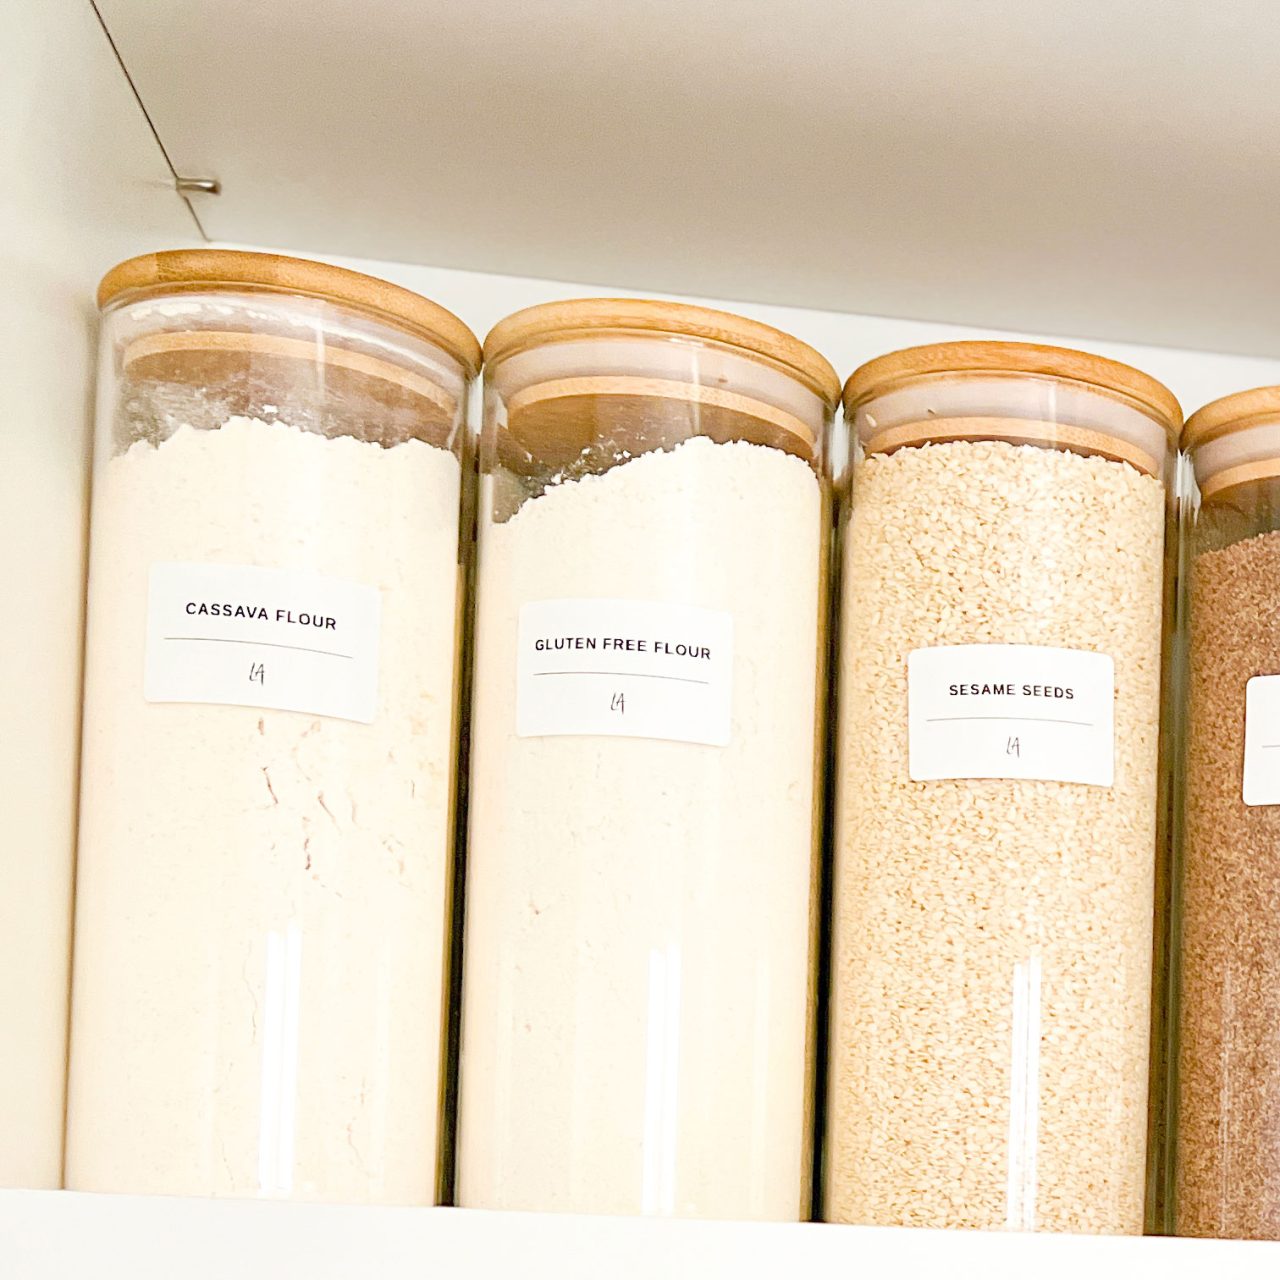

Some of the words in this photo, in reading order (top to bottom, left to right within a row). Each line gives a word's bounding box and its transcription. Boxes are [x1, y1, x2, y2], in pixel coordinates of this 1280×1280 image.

[184, 601, 268, 622] CASSAVA
[275, 609, 337, 631] FLOUR
[534, 636, 597, 652] GLUTEN
[603, 637, 648, 654] FREE
[653, 641, 711, 660] FLOUR
[949, 683, 1015, 697] SESAME
[1021, 685, 1075, 700] SEEDS
